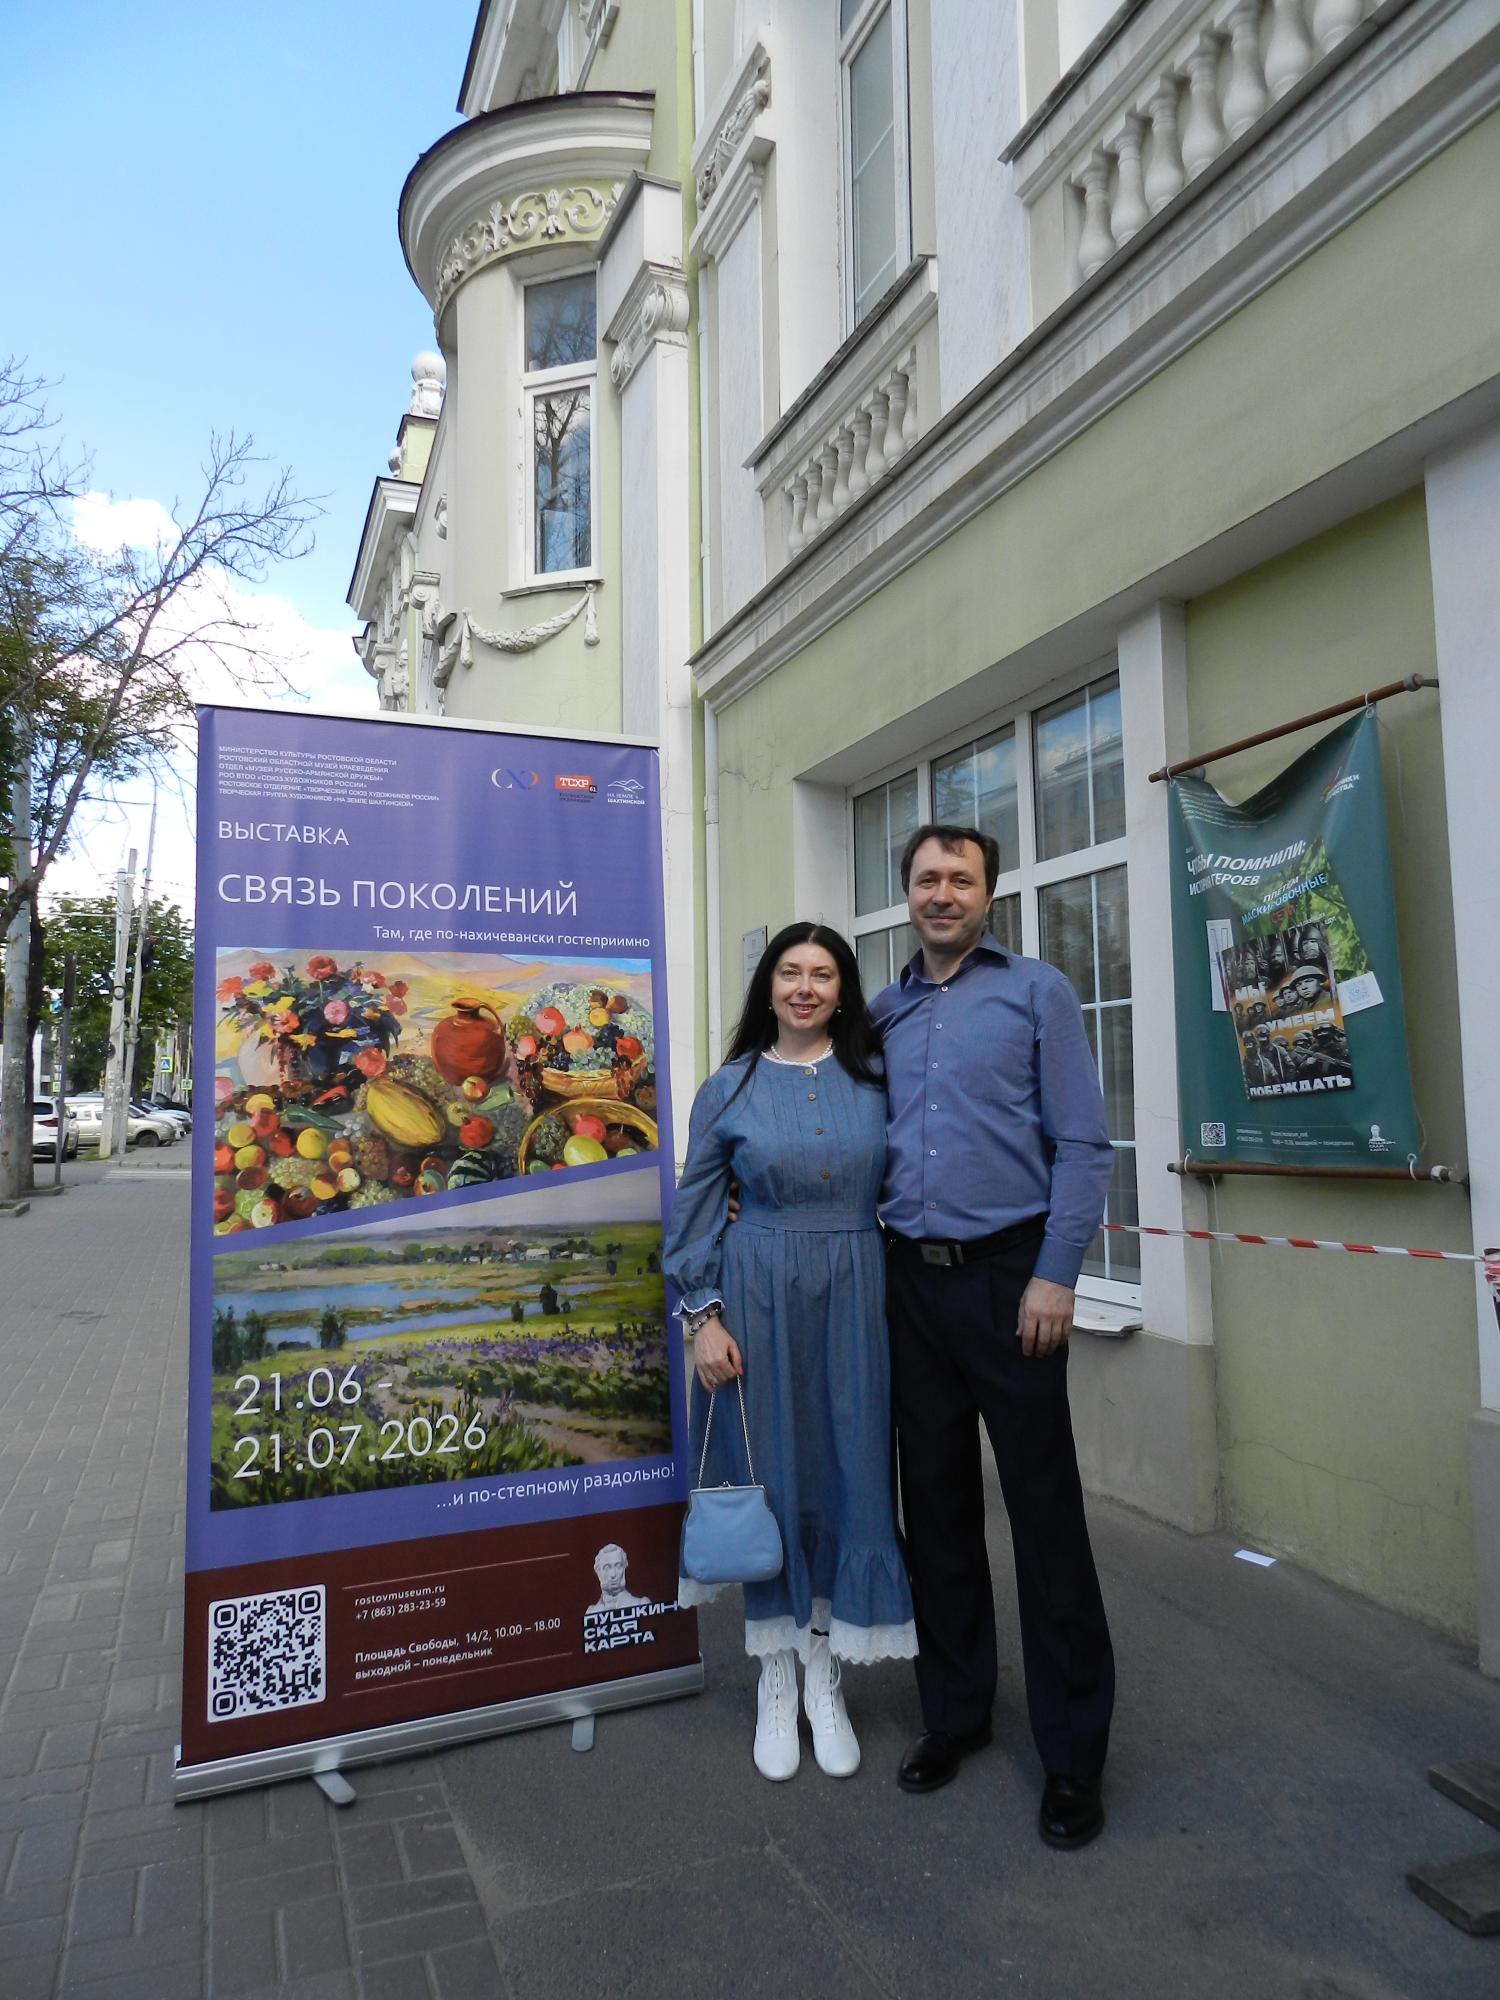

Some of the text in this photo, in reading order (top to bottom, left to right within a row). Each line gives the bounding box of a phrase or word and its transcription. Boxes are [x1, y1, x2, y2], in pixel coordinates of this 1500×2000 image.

[219, 746, 397, 766] МИНИСТЕРСТВО КУЛЬТУРЫ РОСТОВСКОЙ ОБЛАСТИ
[219, 755, 268, 763] РОСТОВСКИЙ
[269, 758, 313, 767] ОБЛАСТНОЙ
[339, 764, 389, 773] КРАЕВЕДЕНИЯ
[219, 763, 383, 781] ОТДЕЛ «МУЗЕЙ РУССКО-АРМЯНСКОЙ ДРУЖБЫ»
[285, 776, 333, 786] ХУДОЖНИКОВ
[219, 780, 262, 789] РОСТОВСКОЕ
[219, 788, 261, 796] ТВОРЧЕСКАЯ
[262, 790, 287, 799] ГРУППА
[218, 820, 349, 846] ВЫСТАВКА
[1214, 840, 1307, 871] ПОМНИЛИ:
[218, 873, 578, 916] СВЯЗЬ ПОКОЛЕНИЙ
[373, 926, 650, 947] Там, где по-нахичевански гостеприимно
[1265, 1008, 1335, 1032] УМЕЕМ
[1249, 1074, 1352, 1097] ПОБЕЖДАТЬ
[233, 1365, 363, 1416] 21.06
[233, 1411, 487, 1479] 21.07.2026
[468, 1478, 580, 1504] по-степному
[582, 1462, 676, 1494] раздольно!
[354, 1585, 445, 1606] rostovmuseum.ru
[356, 1597, 447, 1620] +7 (863) 283-23-59
[583, 1600, 678, 1628] ПУШКИН
[355, 1646, 407, 1664] Площадь
[408, 1637, 460, 1654] Свободы,
[465, 1629, 492, 1644] 14/2,
[495, 1624, 522, 1638] 10.00
[534, 1617, 561, 1632] 18.00
[583, 1620, 638, 1640] СКАЯ
[584, 1630, 655, 1654] КАРТА
[355, 1659, 412, 1680] выходной
[422, 1647, 493, 1668] понедельник
